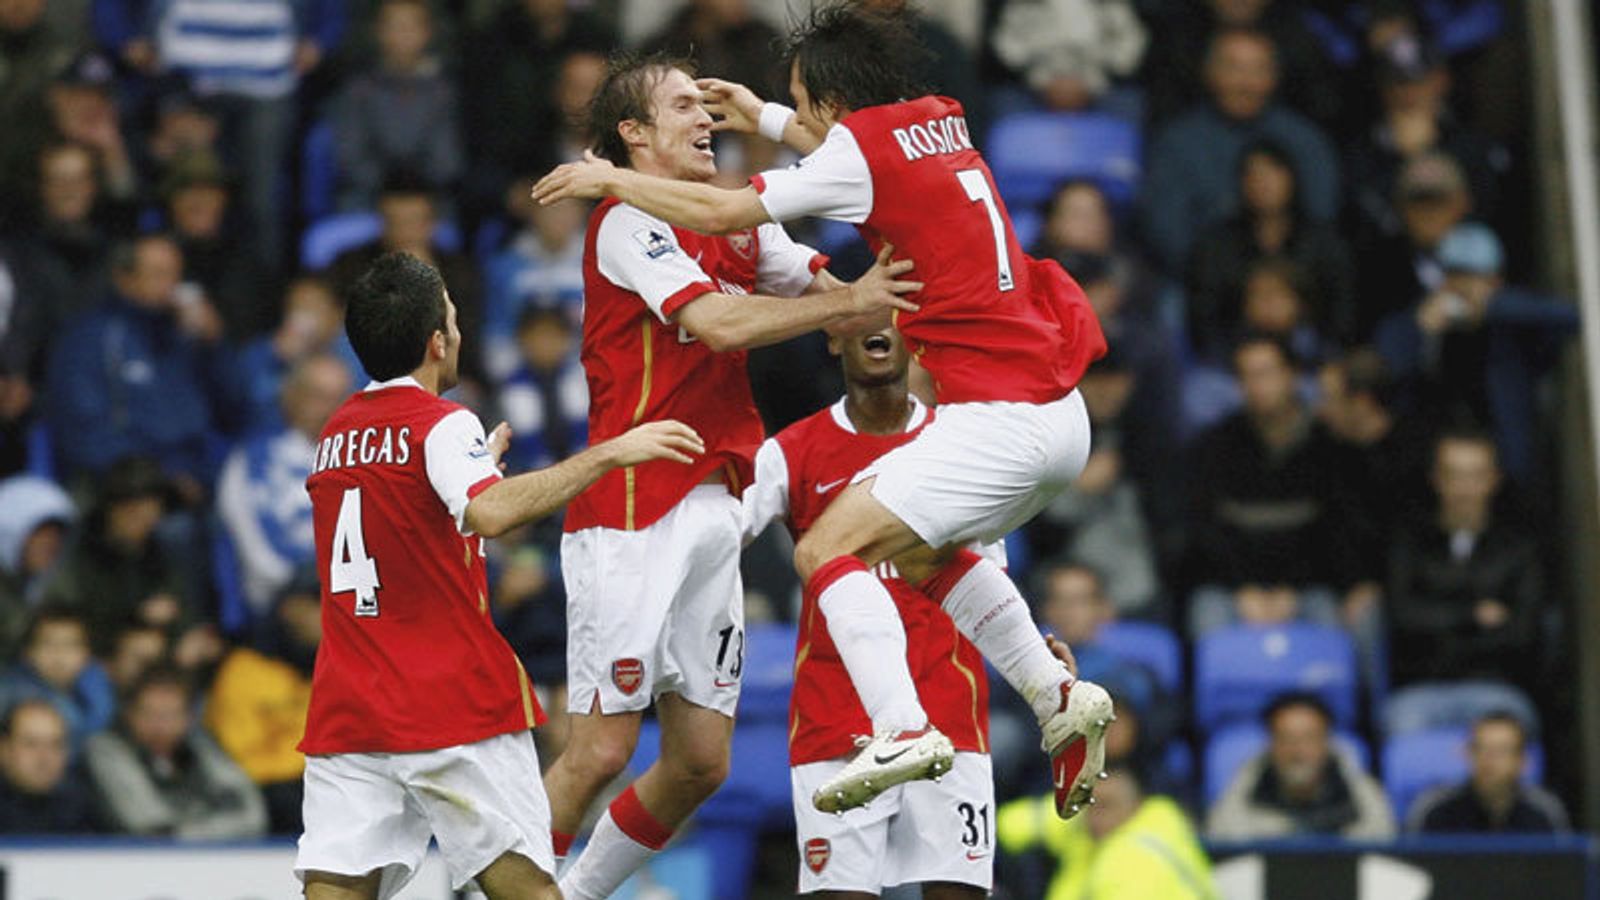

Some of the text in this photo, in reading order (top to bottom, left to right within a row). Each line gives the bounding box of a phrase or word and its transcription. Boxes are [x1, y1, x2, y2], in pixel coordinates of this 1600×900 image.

[955, 168, 1014, 291] 7
[330, 487, 380, 617] 4
[716, 625, 743, 678] 13
[958, 802, 990, 848] 31
